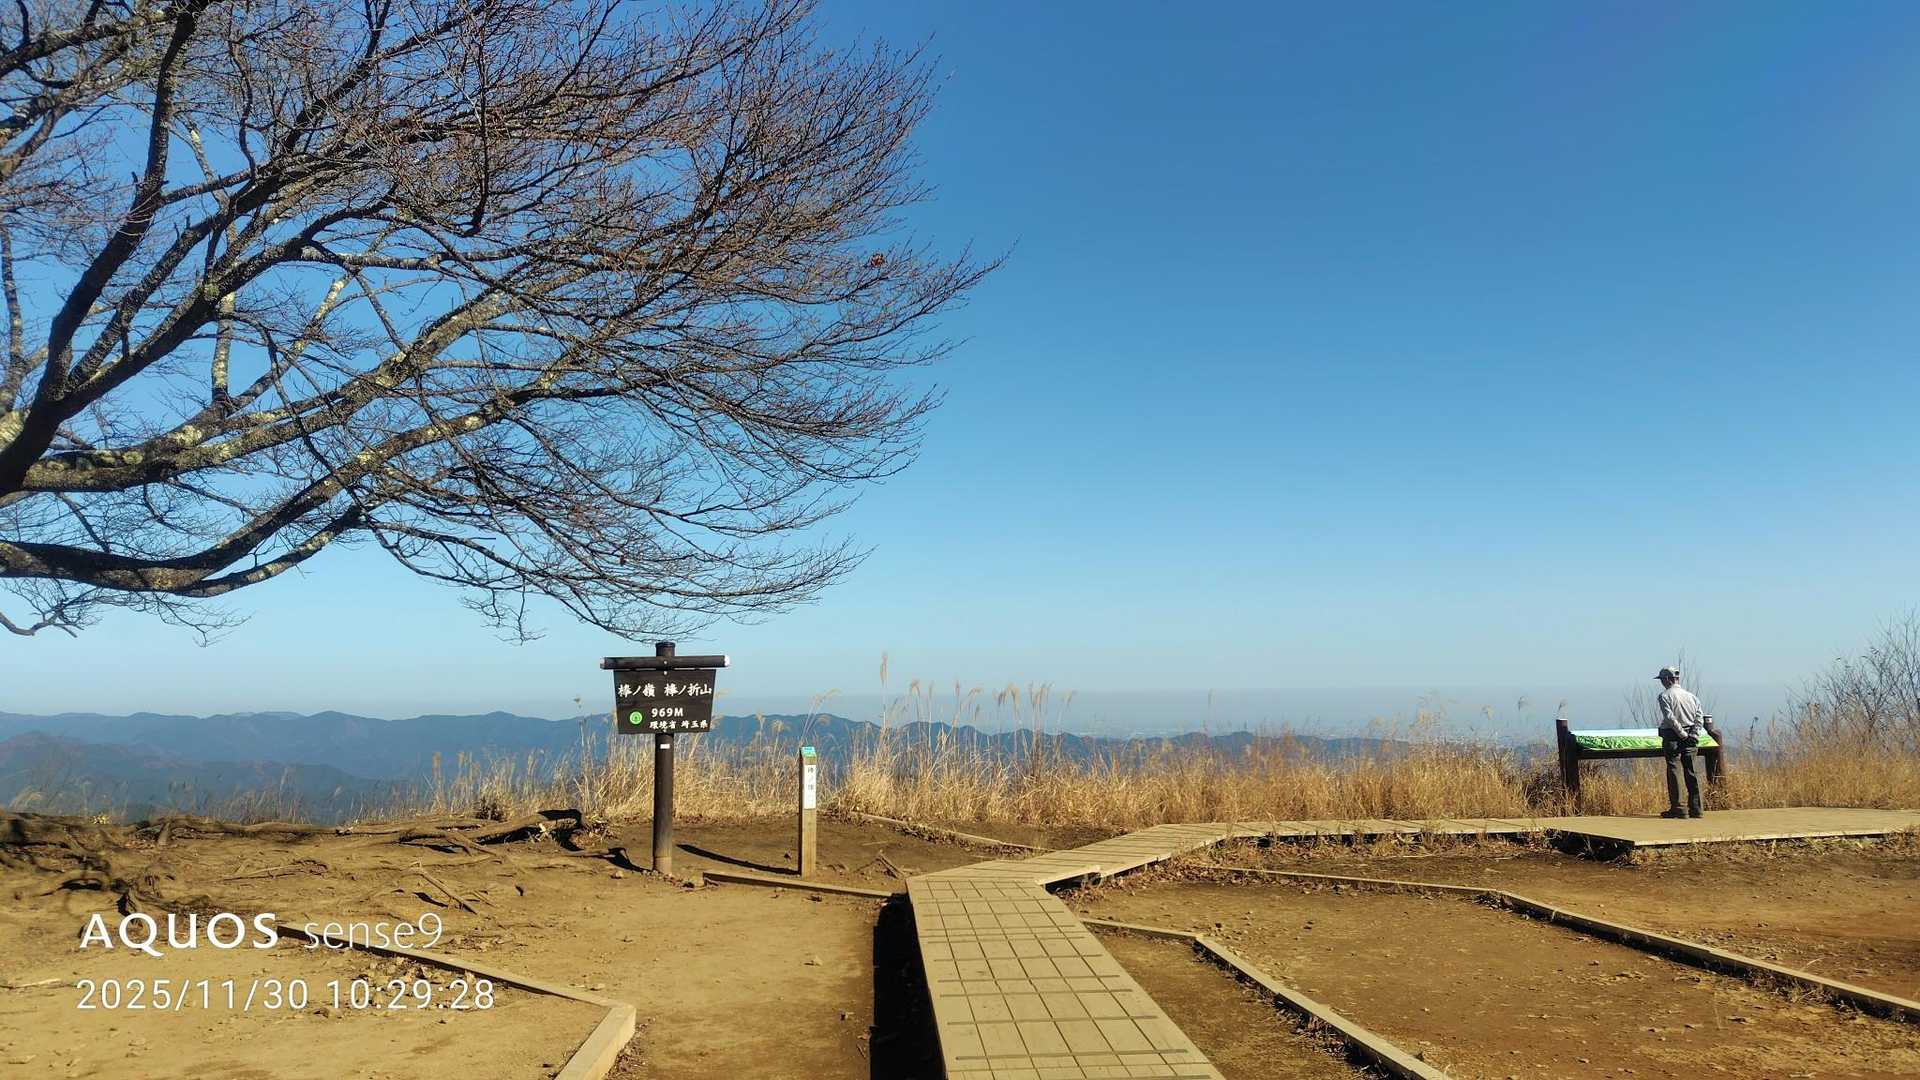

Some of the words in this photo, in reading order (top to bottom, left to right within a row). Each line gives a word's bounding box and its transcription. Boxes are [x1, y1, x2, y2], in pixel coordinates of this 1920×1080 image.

[664, 683, 712, 697] 棒ノ折山
[651, 707, 684, 718] 969M
